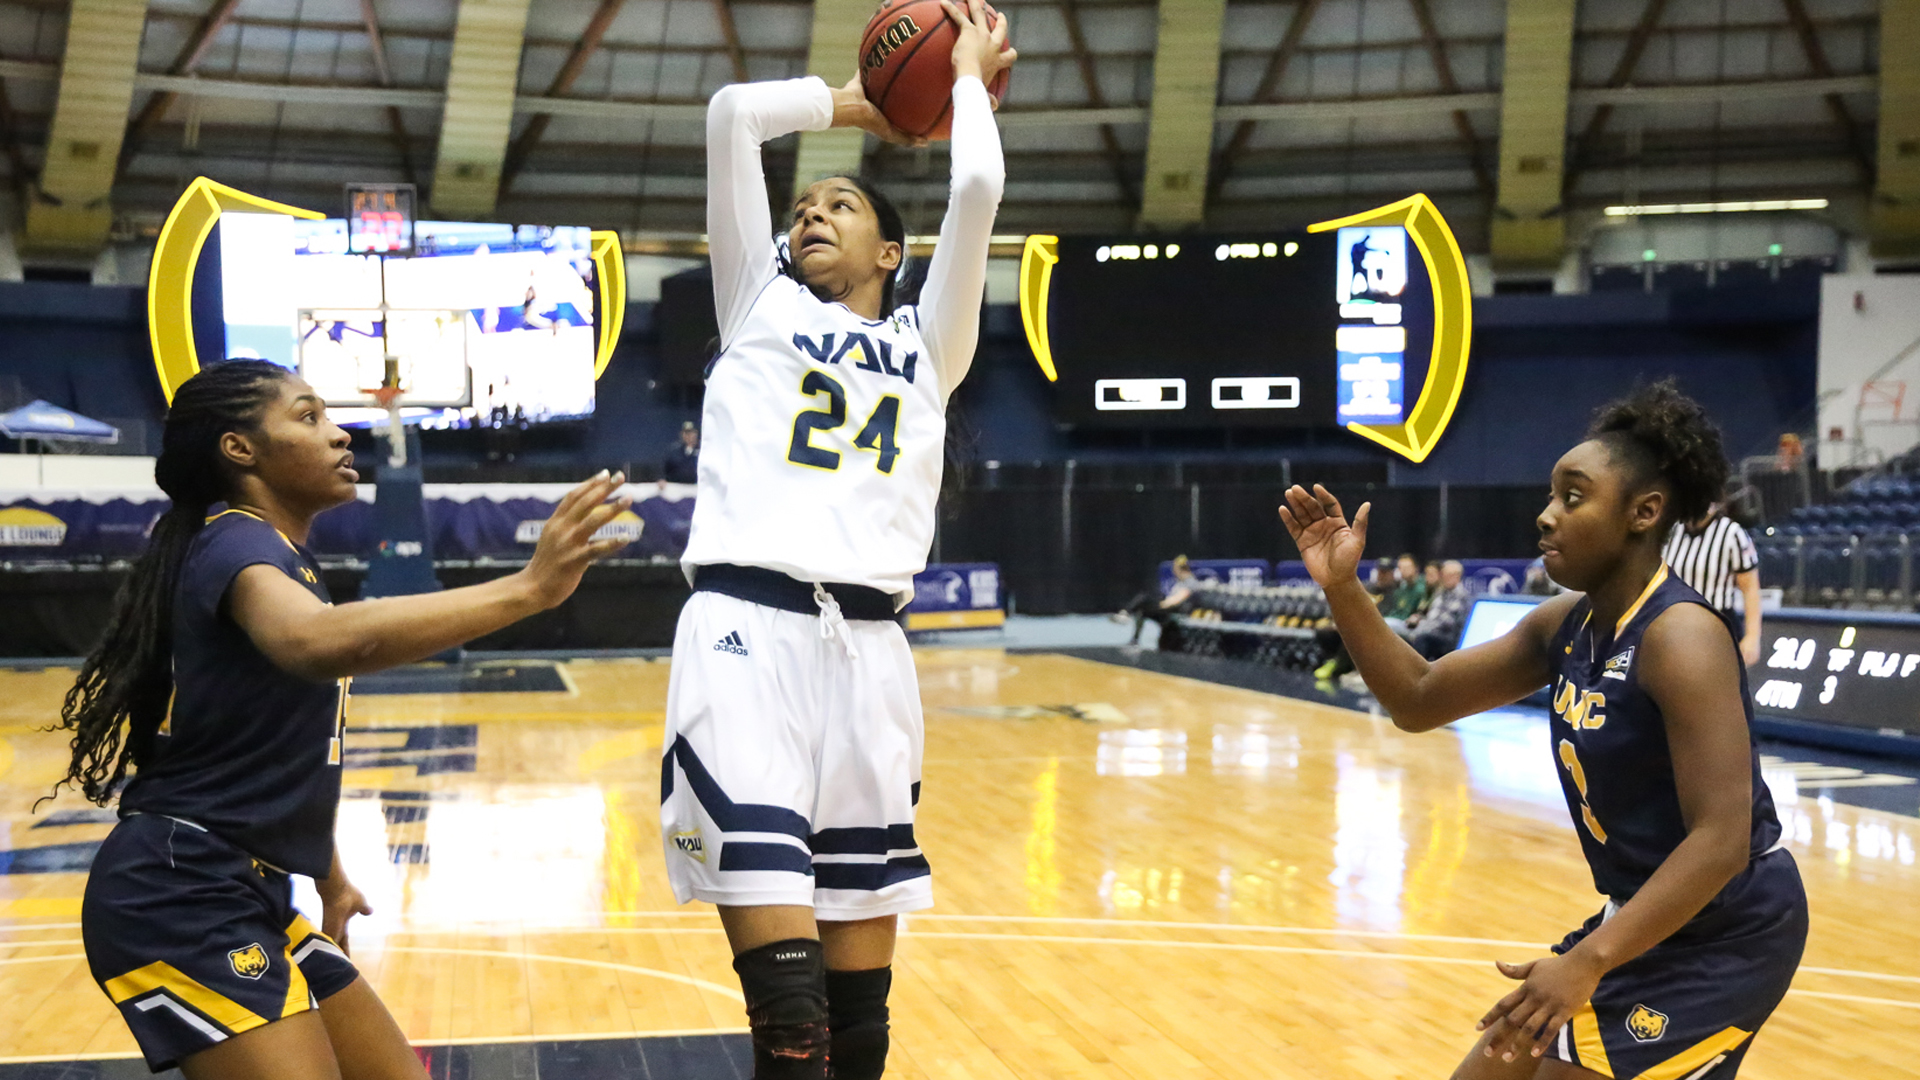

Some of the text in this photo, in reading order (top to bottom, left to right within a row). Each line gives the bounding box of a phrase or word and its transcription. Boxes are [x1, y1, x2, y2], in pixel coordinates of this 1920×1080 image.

[792, 331, 919, 385] NAU
[785, 367, 902, 477] 24
[713, 644, 749, 656] adidas
[1553, 673, 1606, 731] UNC
[675, 837, 703, 852] NAU
